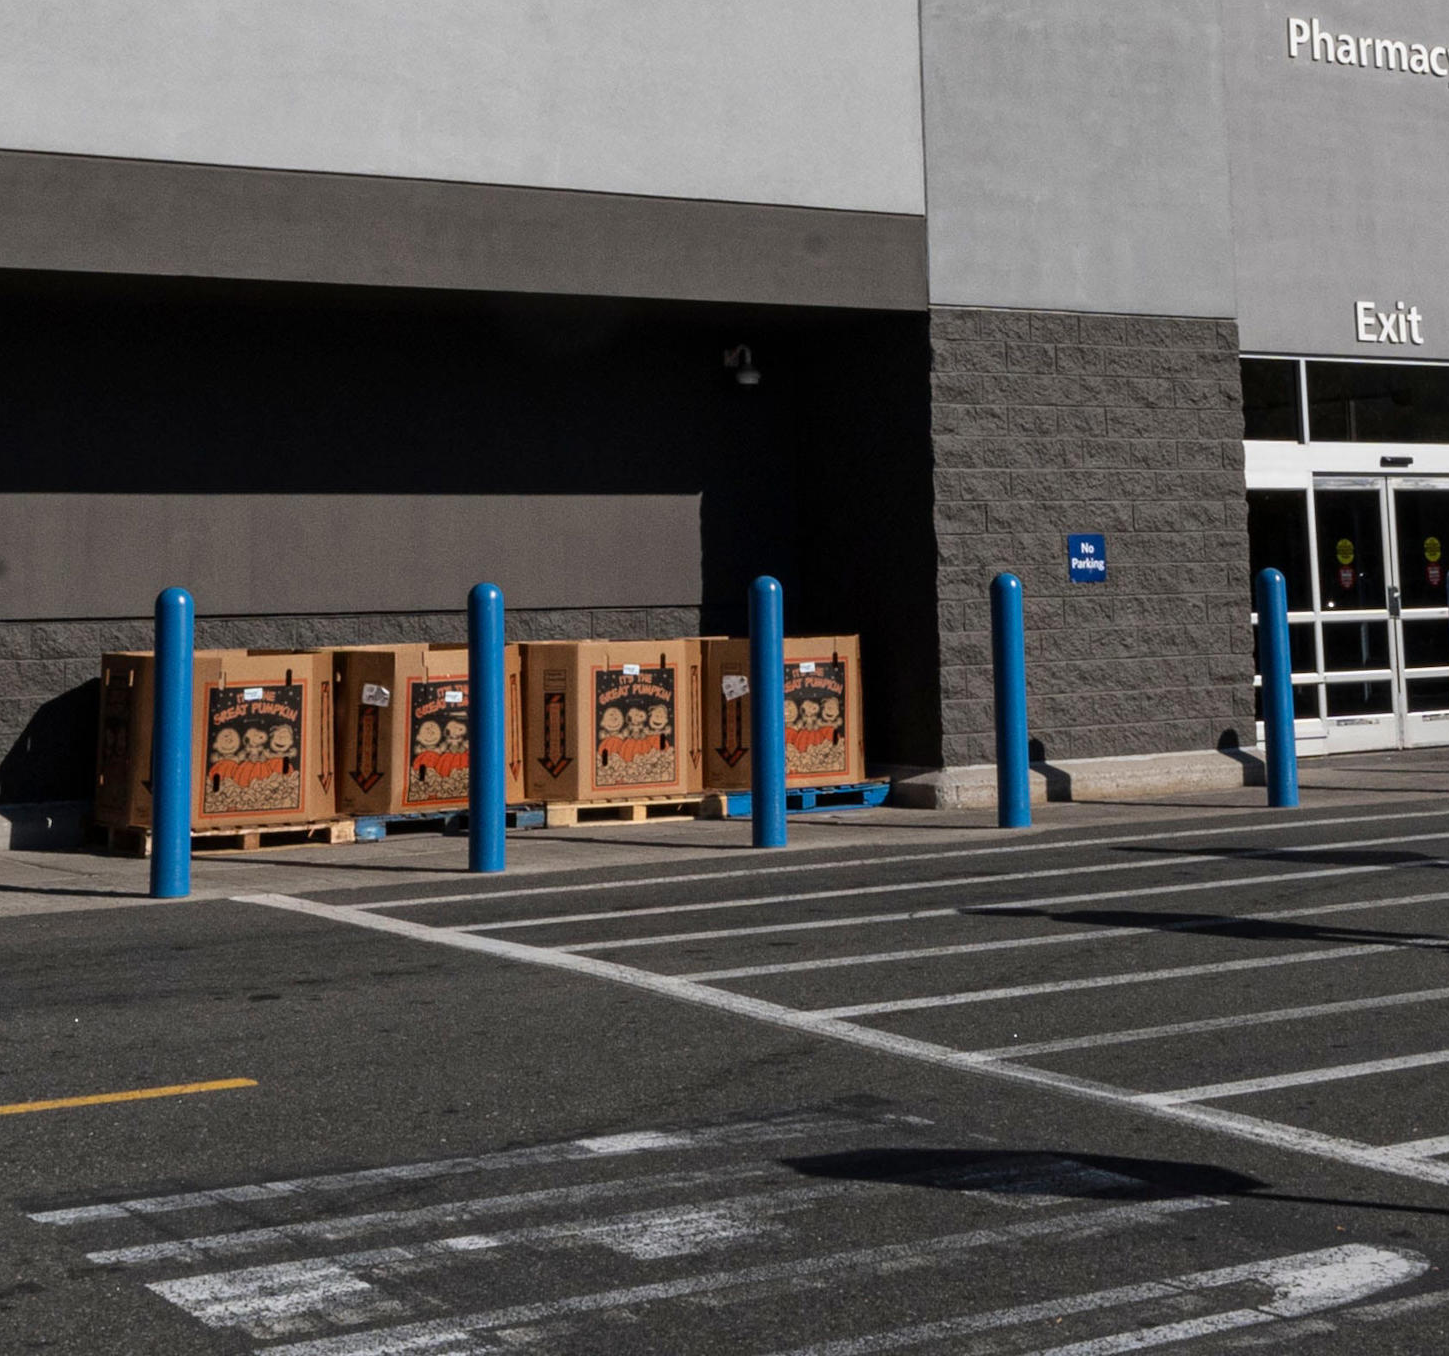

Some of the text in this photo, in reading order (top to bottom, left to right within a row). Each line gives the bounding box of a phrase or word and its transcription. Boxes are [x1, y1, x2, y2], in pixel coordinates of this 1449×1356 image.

[1355, 300, 1425, 347] Exit
[1080, 542, 1095, 554] No
[1071, 557, 1105, 572] Parking
[251, 701, 299, 723] PUMPKIN
